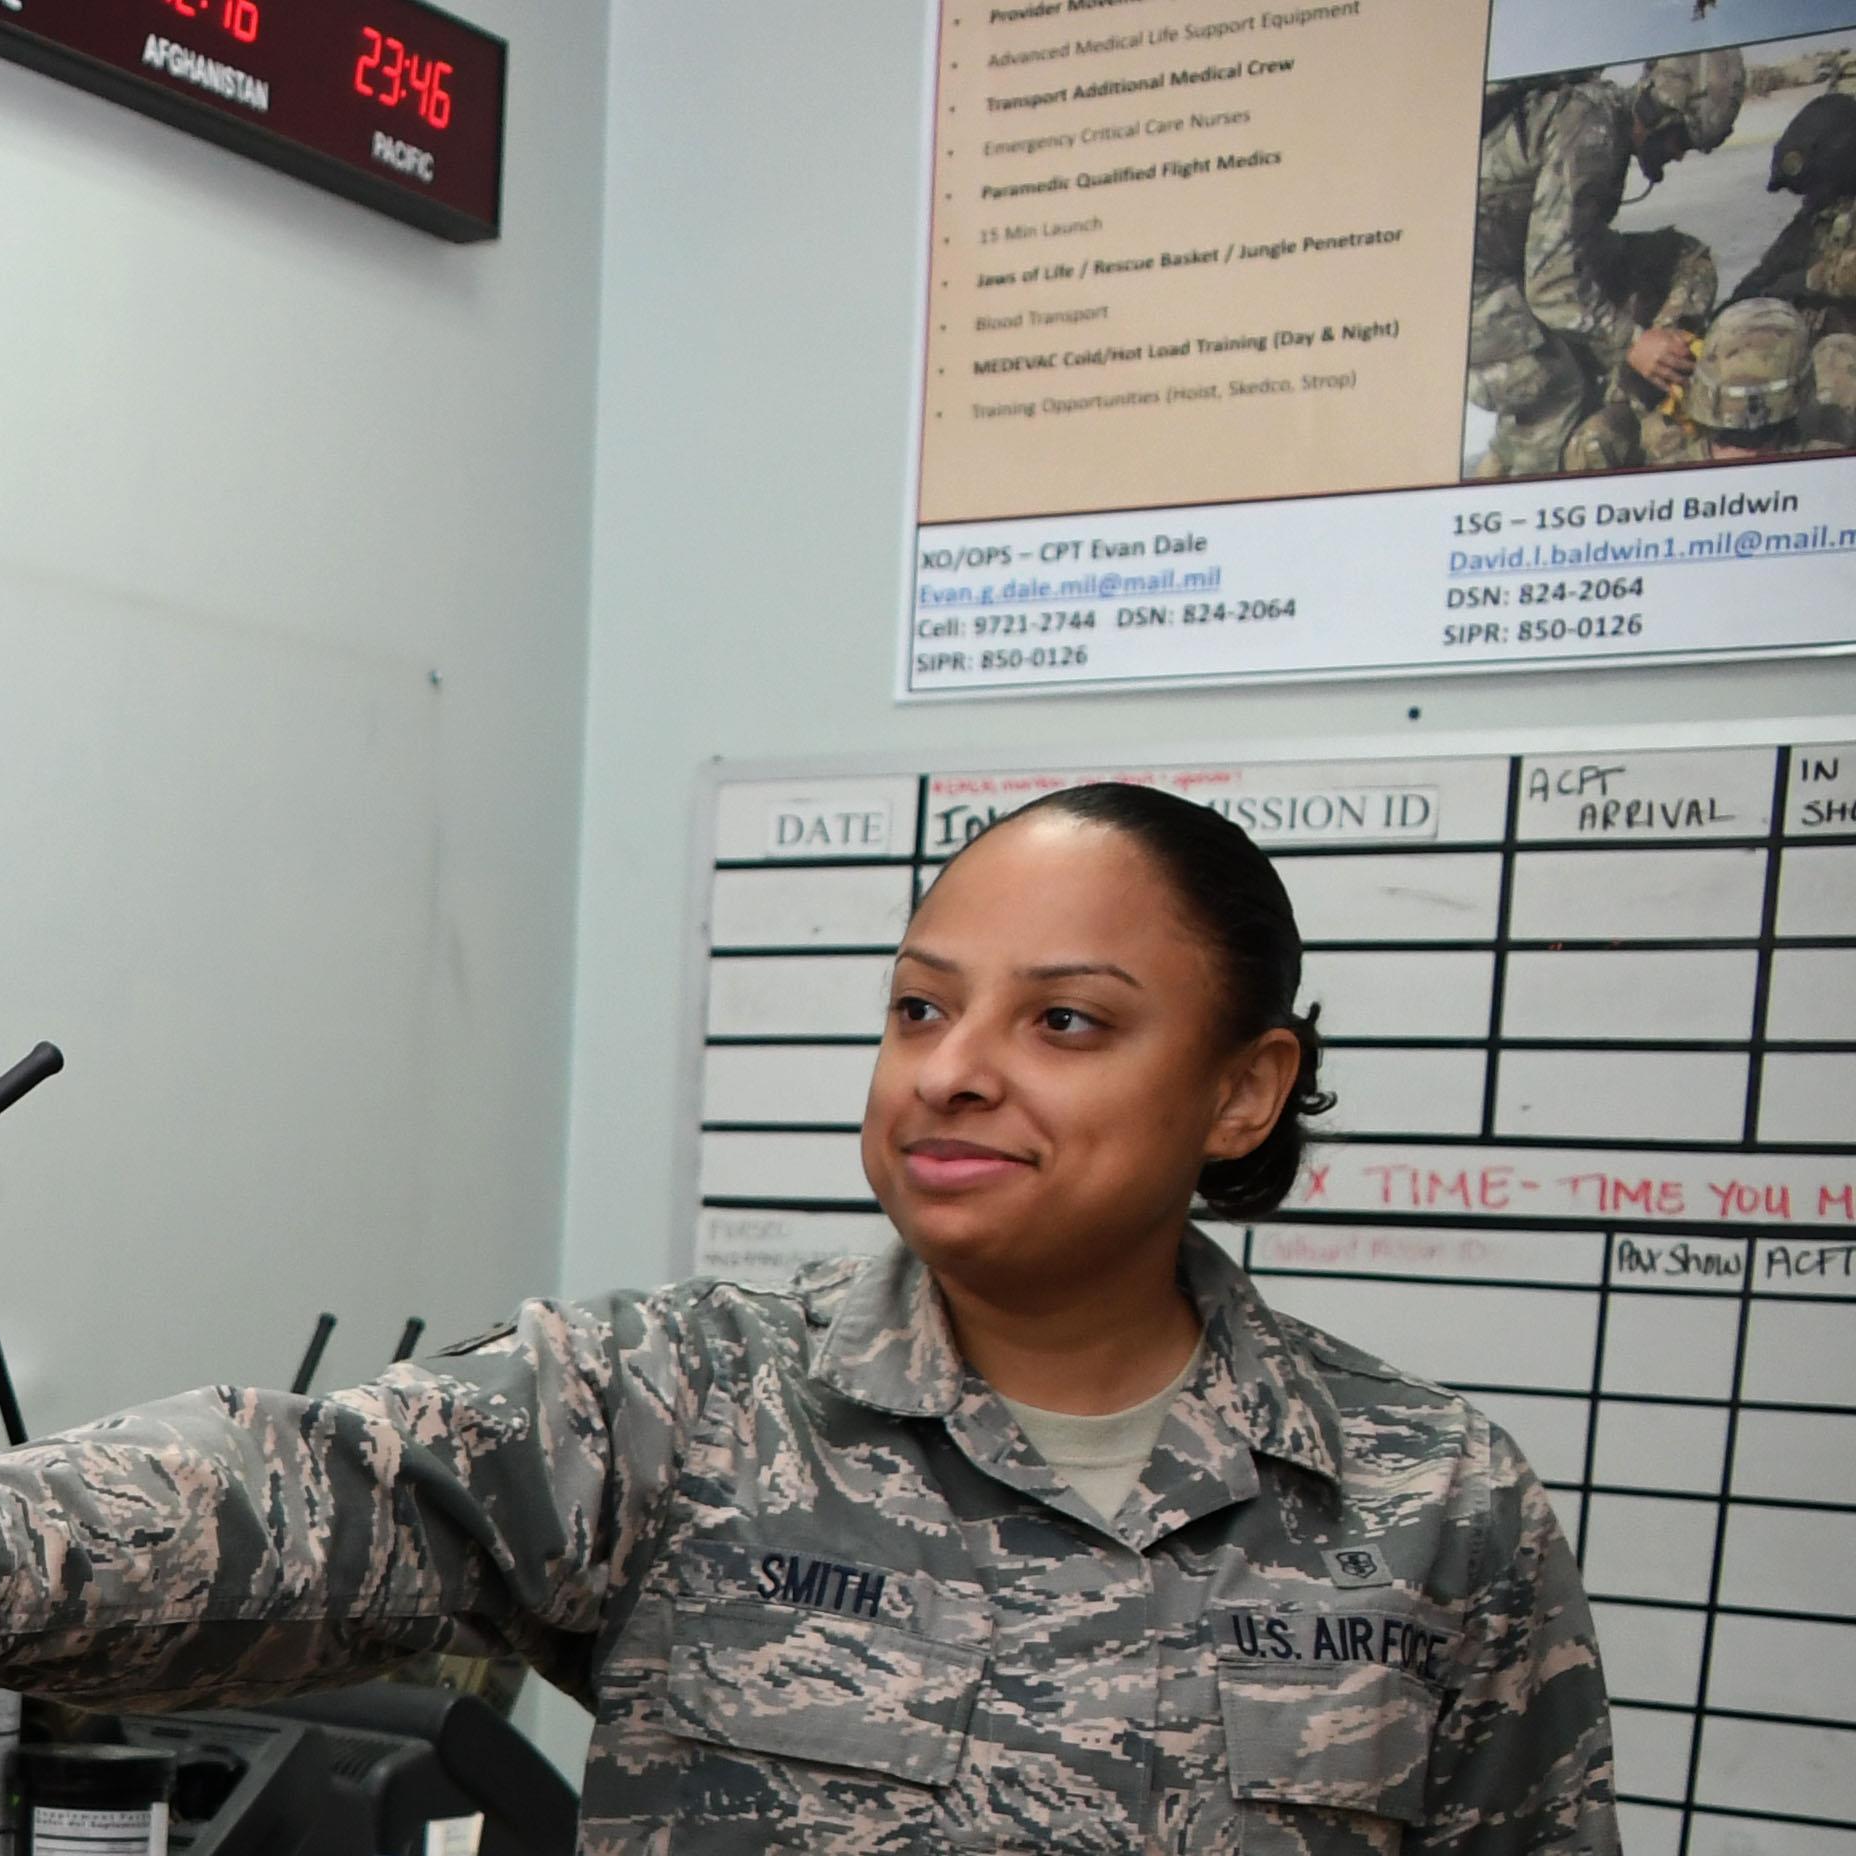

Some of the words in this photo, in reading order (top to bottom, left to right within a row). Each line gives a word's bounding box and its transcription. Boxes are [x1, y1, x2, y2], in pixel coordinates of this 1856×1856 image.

[988, 43, 1070, 68] Advanced
[1075, 31, 1143, 55] Medical
[1148, 25, 1178, 45] Life
[1185, 16, 1255, 41] Support
[1261, 0, 1360, 31] Equipment
[143, 33, 269, 113] AFGHANISTAN
[355, 26, 453, 129] 23:46
[987, 88, 1068, 114] Transport
[1073, 73, 1164, 99] Additional
[1170, 62, 1241, 86] Medical
[1247, 56, 1295, 77] Crew
[984, 130, 1074, 157] Emergency
[1081, 122, 1141, 144] Critical
[1145, 117, 1184, 136] Care
[1190, 109, 1251, 129] Nurses
[371, 130, 435, 183] PACIFIC
[982, 176, 1069, 201] Paramedic
[1077, 163, 1156, 190] Qualified
[1162, 157, 1211, 180] Flight
[1217, 150, 1282, 171] Medics
[1042, 216, 1103, 239] Launch
[976, 270, 1016, 290] Jaws
[1094, 255, 1155, 276] Rescue
[1161, 247, 1219, 267] Basket
[1239, 238, 1297, 262] Jungle
[1303, 227, 1403, 253] Penetrator
[976, 312, 1023, 332] Blood
[1029, 304, 1110, 330] Transport
[974, 352, 1058, 376] MEDEVAC
[1063, 342, 1142, 368] Cold/Hot
[1149, 339, 1190, 360] Load
[1197, 333, 1267, 356] Training
[1342, 319, 1400, 341] Night)
[973, 400, 1036, 420] Training
[1042, 388, 1160, 414] Opportunities
[1453, 511, 1502, 536] 1SG
[1536, 505, 1586, 530] 1SG
[1596, 498, 1673, 525] David
[1683, 490, 1799, 519] Baldwin
[1040, 540, 1083, 562] CPT
[1092, 537, 1145, 559] Evan
[1154, 532, 1208, 555] Dale
[1447, 586, 1510, 609] DSN:
[1519, 576, 1644, 604] 824-2064
[918, 618, 966, 639] Cell:
[974, 609, 1096, 636] 9721-2744
[1117, 606, 1175, 628] DSN:
[1183, 598, 1297, 624] 824-2064
[1443, 623, 1509, 646] SIPR:
[1518, 614, 1642, 642] 850-0126
[917, 651, 973, 673] SIPR:
[981, 645, 1088, 670] 850-0126
[1801, 757, 1838, 782] IN
[776, 810, 883, 846] DATE
[1384, 793, 1431, 829] ID
[1579, 800, 1734, 831] ARRIVAL
[1707, 1181, 1789, 1219] YOU
[758, 1553, 886, 1618] SMITH
[1233, 1615, 1302, 1660] U.S.
[1314, 1617, 1375, 1661] AIR
